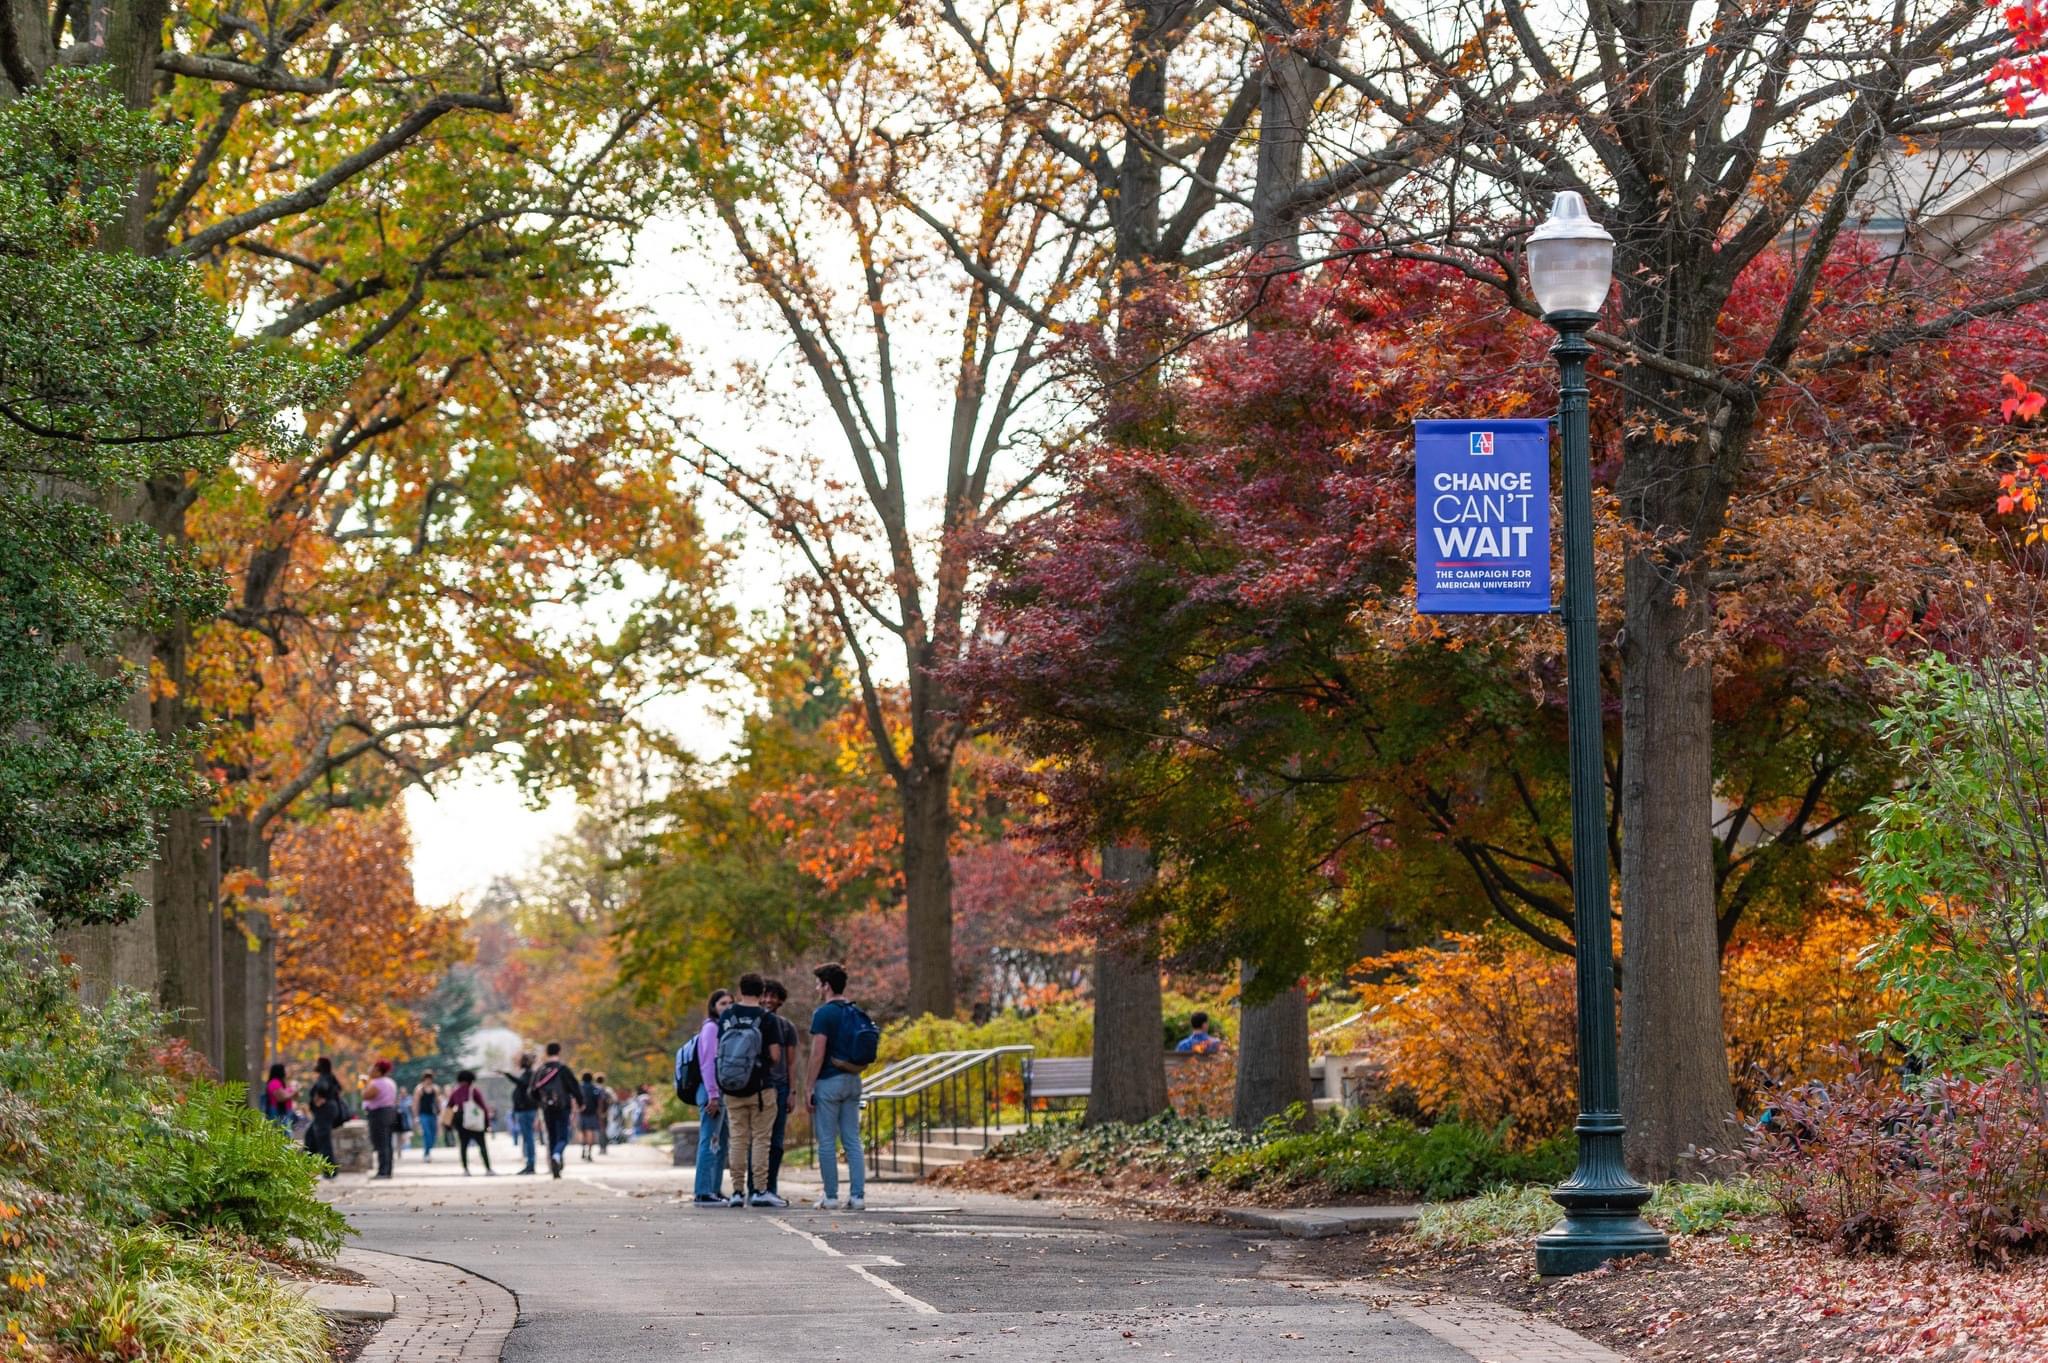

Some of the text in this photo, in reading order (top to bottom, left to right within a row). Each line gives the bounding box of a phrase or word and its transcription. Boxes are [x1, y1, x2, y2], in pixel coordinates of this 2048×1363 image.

[1433, 472, 1531, 491] CHANGE
[1433, 494, 1534, 524] CAN'T
[1433, 526, 1533, 558] WAIT
[1436, 570, 1531, 578] THE CAMPAIGN FOR
[1436, 581, 1532, 589] AMERICAN UNIVERSITY
